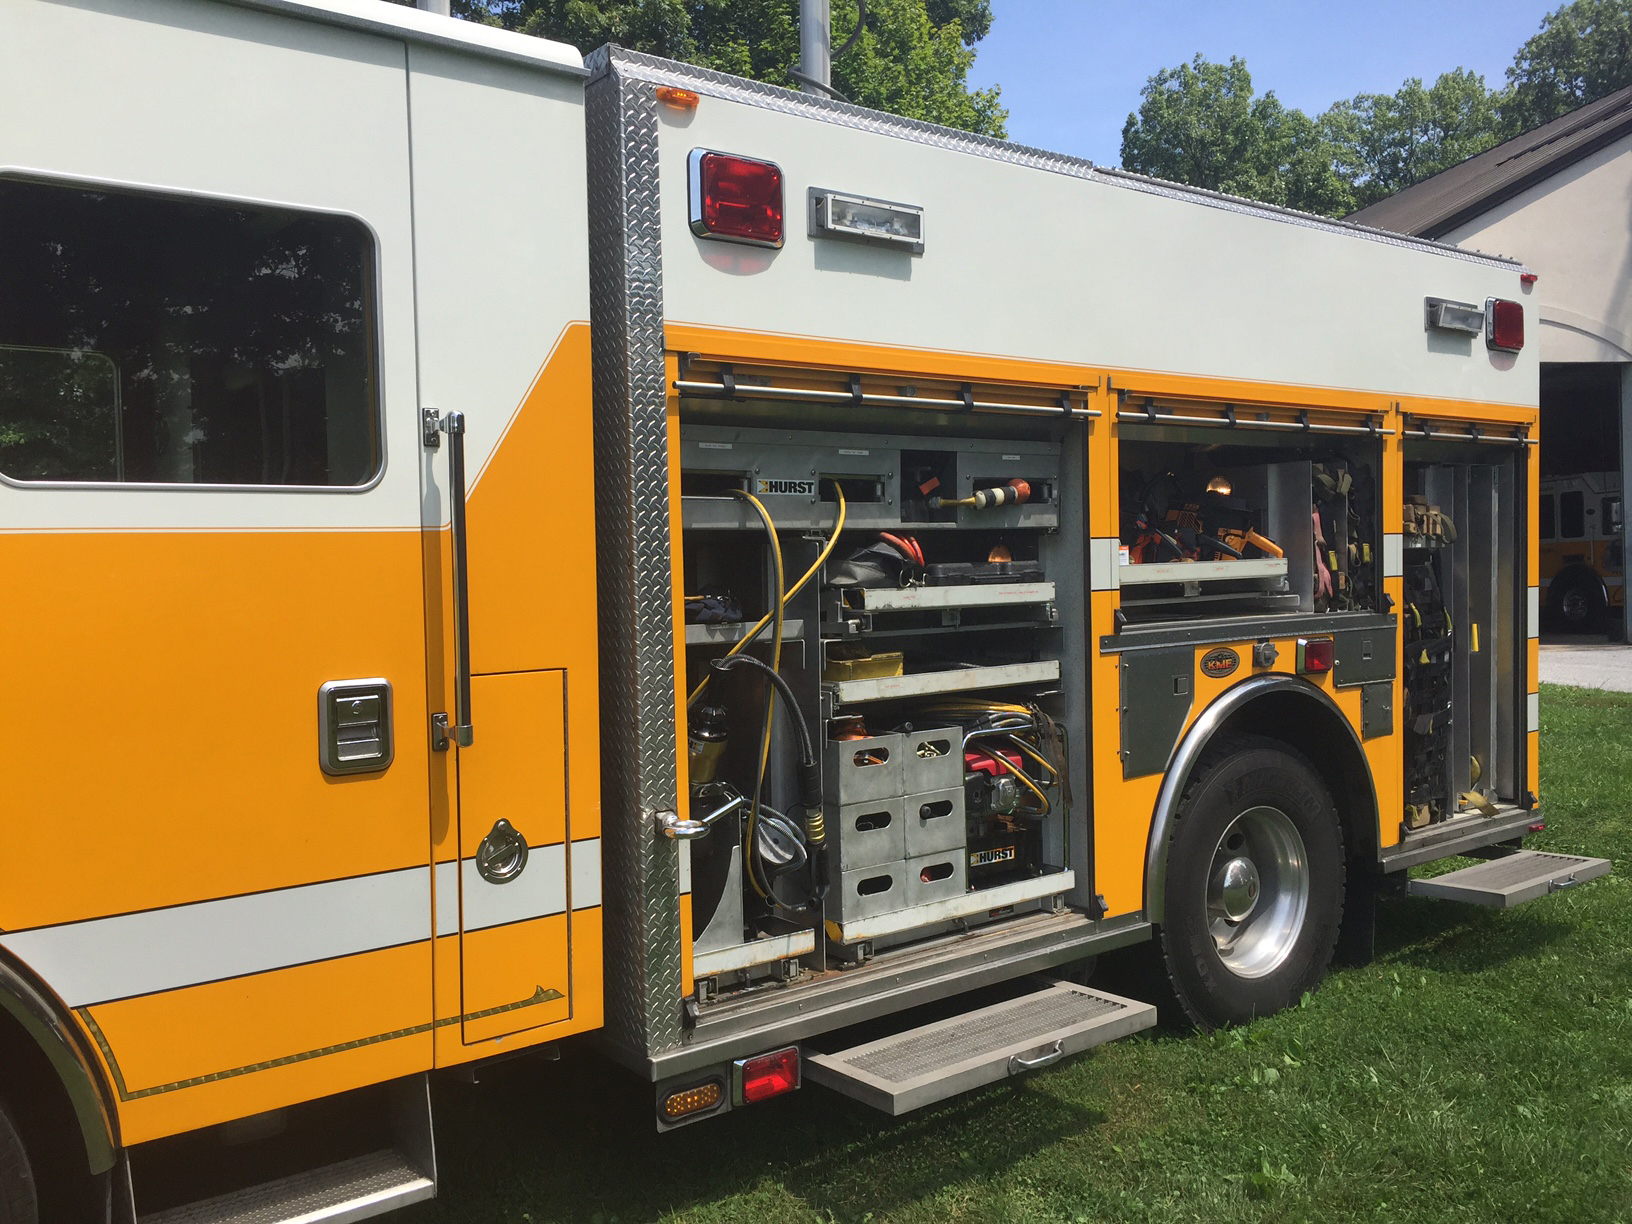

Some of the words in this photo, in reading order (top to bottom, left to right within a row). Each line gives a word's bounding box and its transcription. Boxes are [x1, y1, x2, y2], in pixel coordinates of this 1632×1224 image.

[769, 480, 814, 494] HURST
[1208, 658, 1233, 671] KME
[980, 847, 1014, 863] HURST
